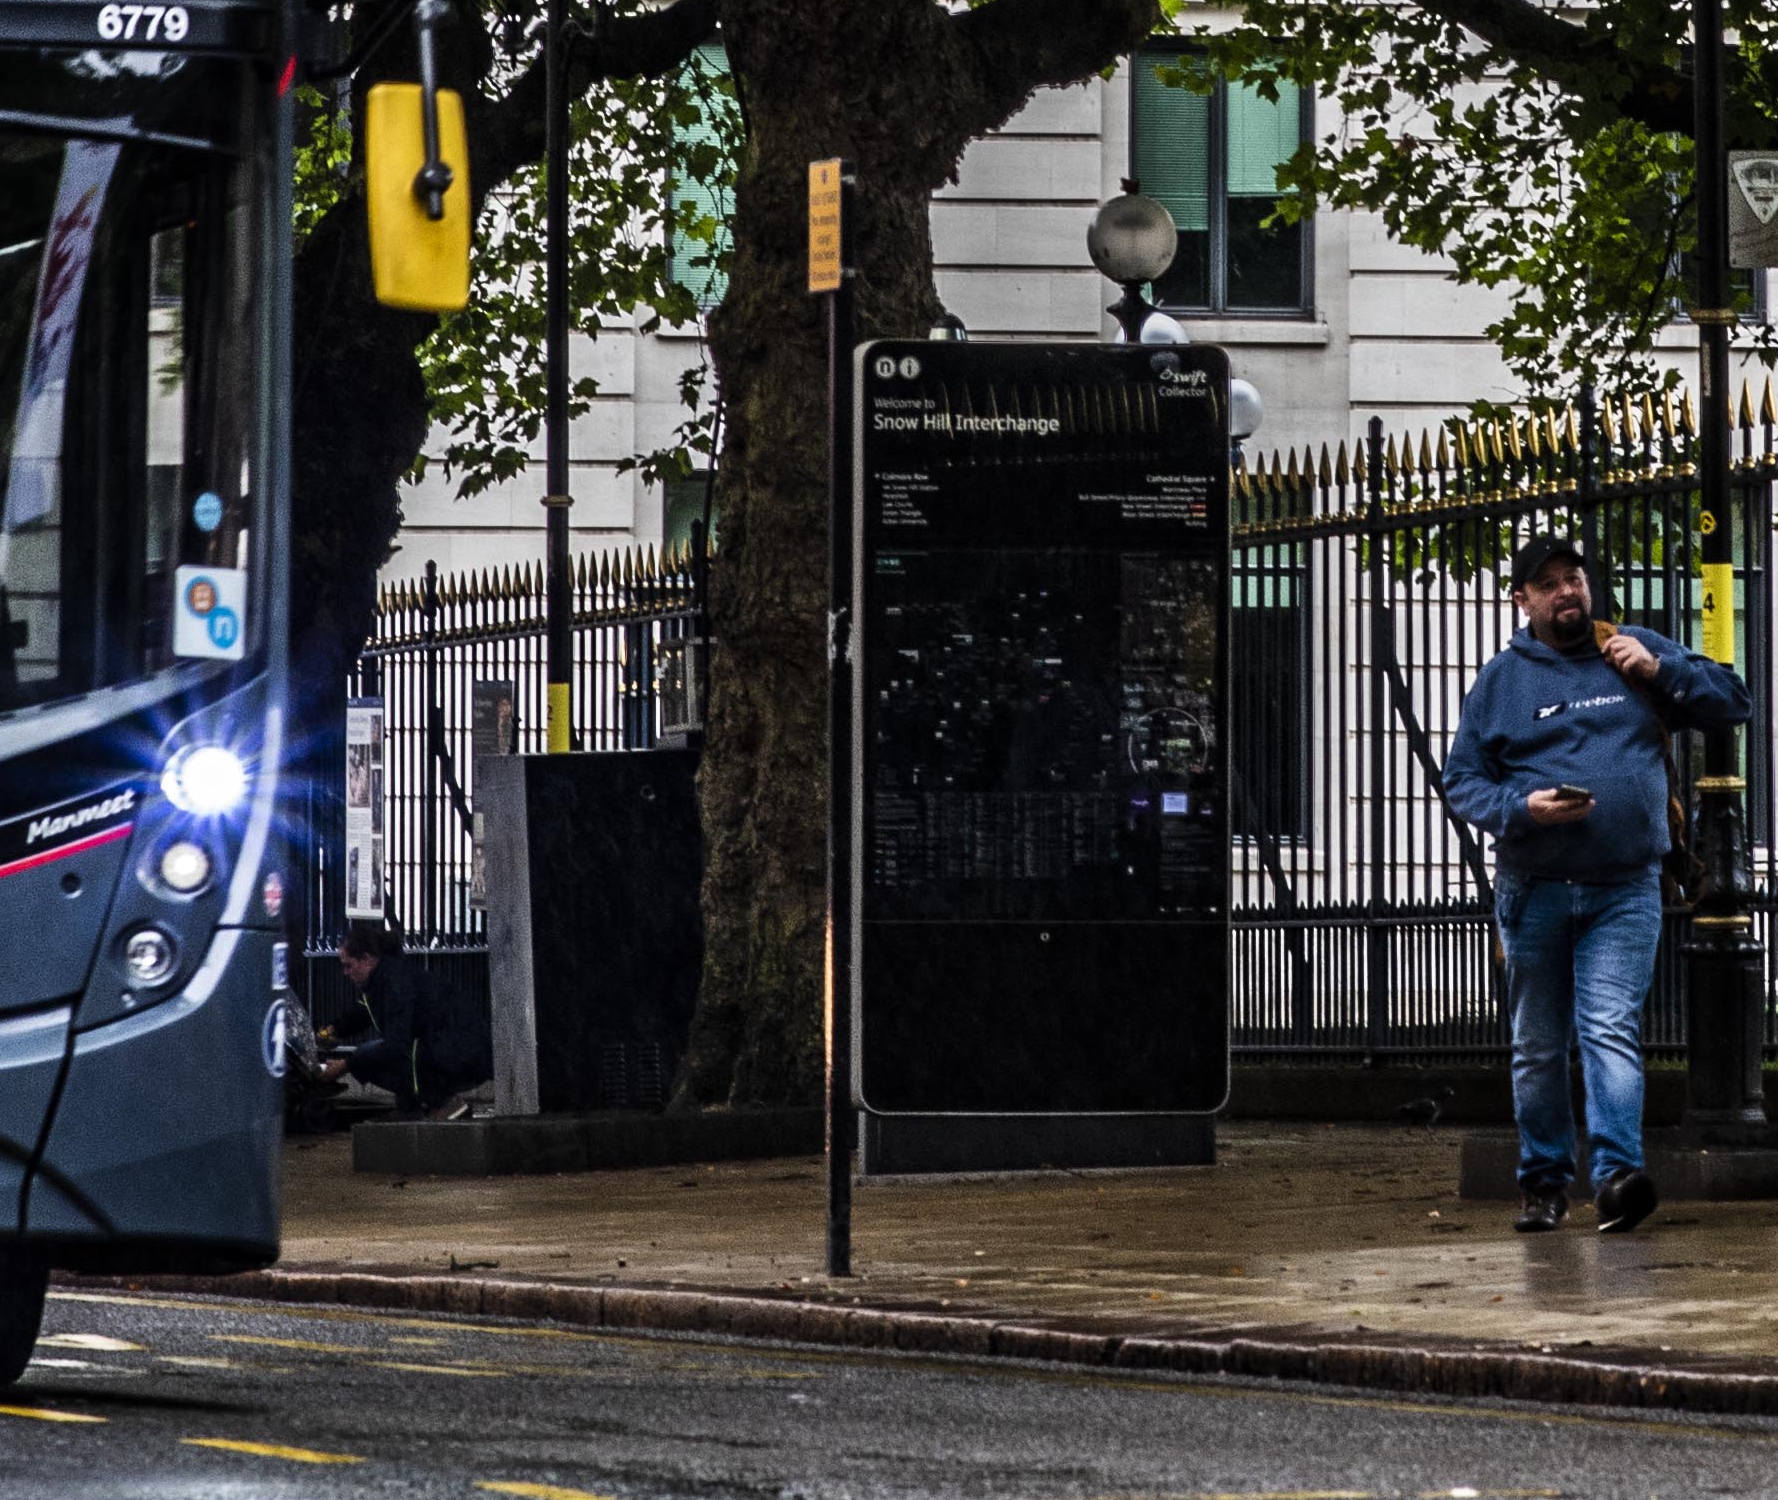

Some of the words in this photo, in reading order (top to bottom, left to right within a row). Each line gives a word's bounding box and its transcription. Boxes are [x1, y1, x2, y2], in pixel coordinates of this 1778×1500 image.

[97, 3, 190, 42] 6779
[1173, 370, 1208, 386] swift
[1158, 386, 1208, 397] Collector
[873, 414, 920, 431] Snow
[924, 413, 951, 431] Hill
[955, 414, 1061, 436] Interchange
